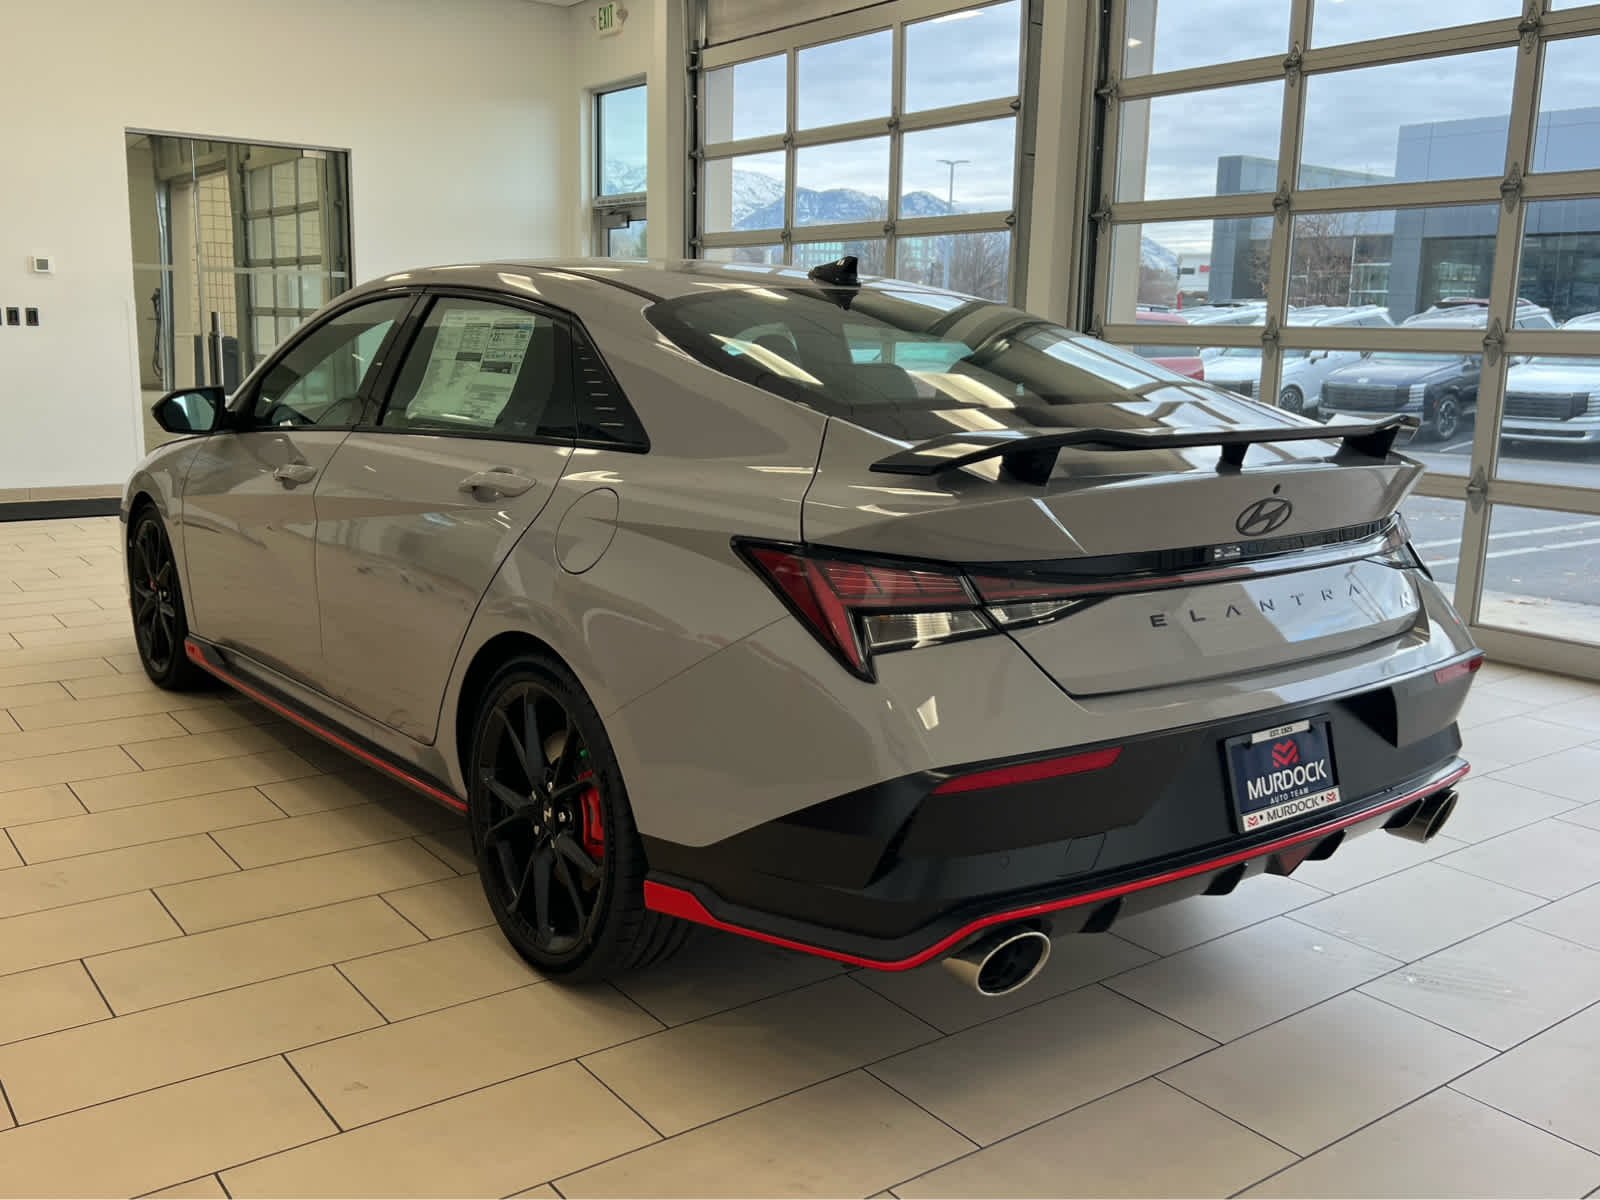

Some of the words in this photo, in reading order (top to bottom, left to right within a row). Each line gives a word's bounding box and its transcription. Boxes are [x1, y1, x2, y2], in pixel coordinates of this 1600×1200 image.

[598, 4, 613, 31] EXIT
[1150, 584, 1361, 628] ELANTRA
[1247, 759, 1328, 800] MURDOCK
[1270, 792, 1289, 804] AUTO
[1290, 787, 1309, 797] TEAM
[1266, 797, 1319, 822] MURDOCK
